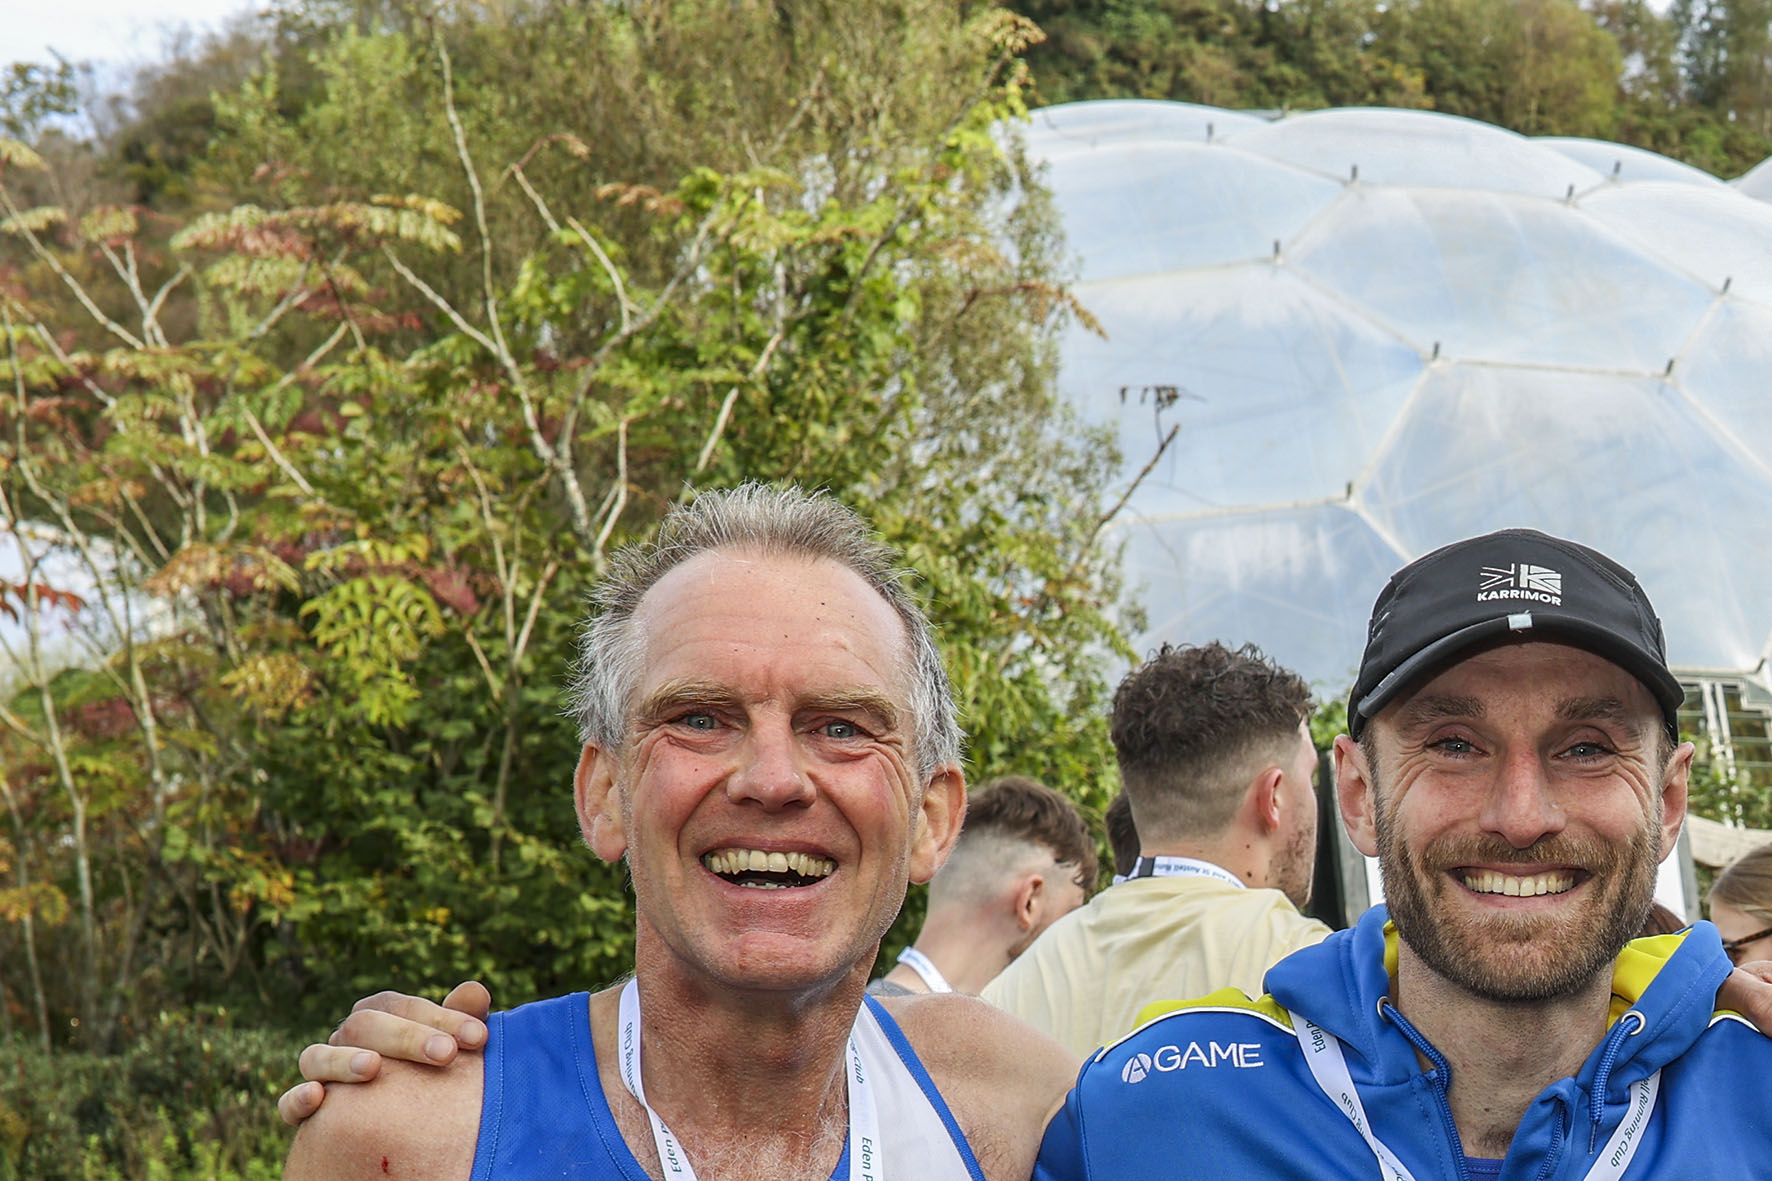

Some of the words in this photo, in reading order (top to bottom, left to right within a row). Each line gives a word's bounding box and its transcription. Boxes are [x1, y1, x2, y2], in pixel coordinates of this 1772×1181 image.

[1311, 1028, 1326, 1054] Eden
[854, 1056, 865, 1084] Club
[1341, 1092, 1357, 1121] Club
[1624, 1092, 1649, 1141] Running
[666, 1140, 682, 1173] Eden
[861, 1137, 873, 1169] Eden
[1610, 1140, 1629, 1168] Club
